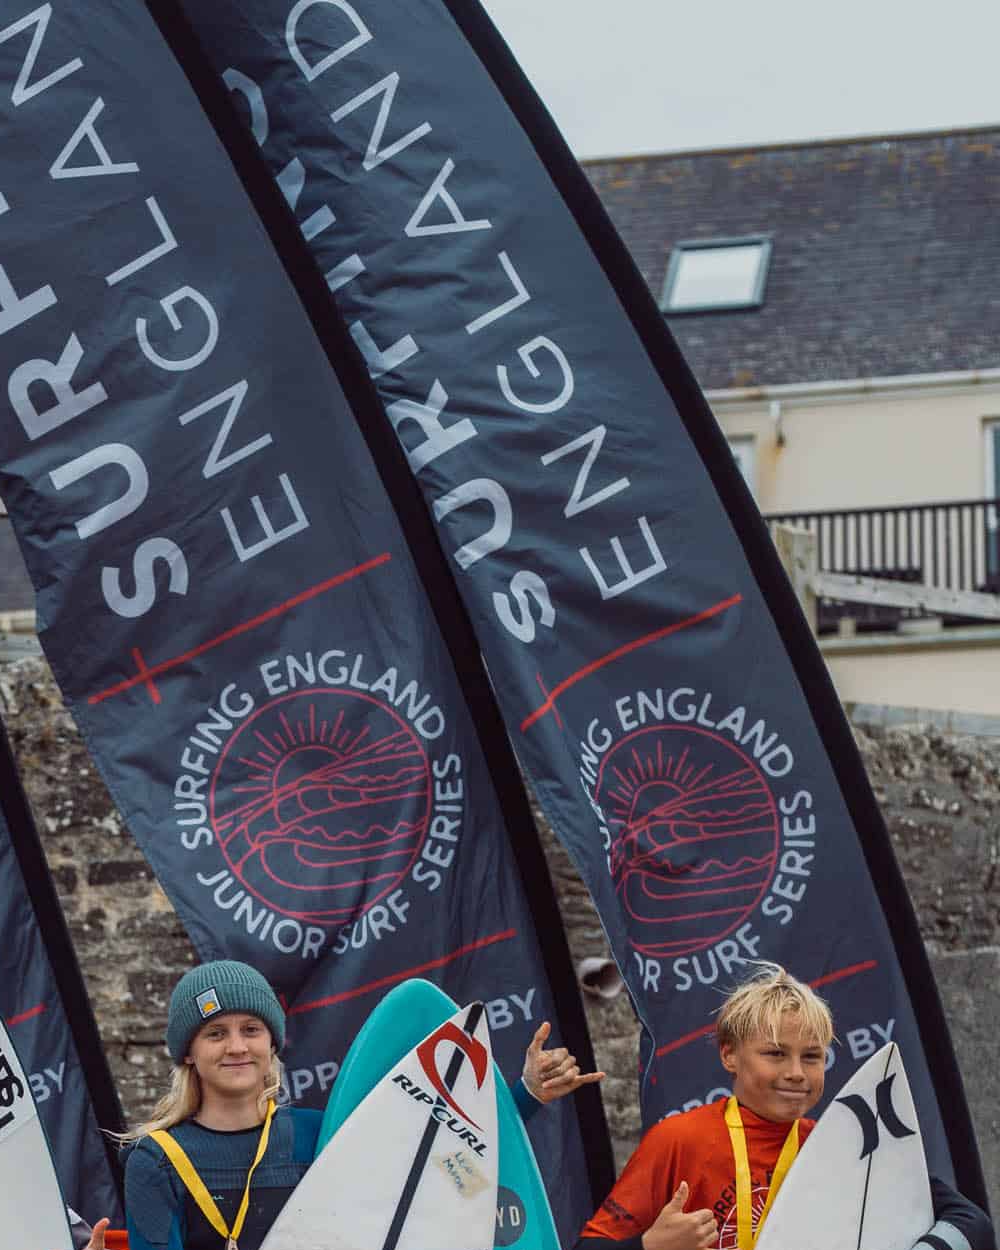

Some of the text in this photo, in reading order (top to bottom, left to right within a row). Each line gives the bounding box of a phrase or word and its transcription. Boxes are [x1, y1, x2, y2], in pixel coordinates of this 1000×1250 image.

[285, 0, 668, 600] ENGLAND
[174, 650, 446, 850] SURFING ENGLAND
[615, 687, 795, 778] ENGLAND
[196, 753, 465, 959] JUNIOR SURF SERIES
[673, 788, 816, 992] SURF SERIES
[489, 988, 537, 1031] BY
[846, 1018, 897, 1060] BY
[32, 1061, 66, 1104] BY
[391, 1072, 490, 1158] RIP CURL
